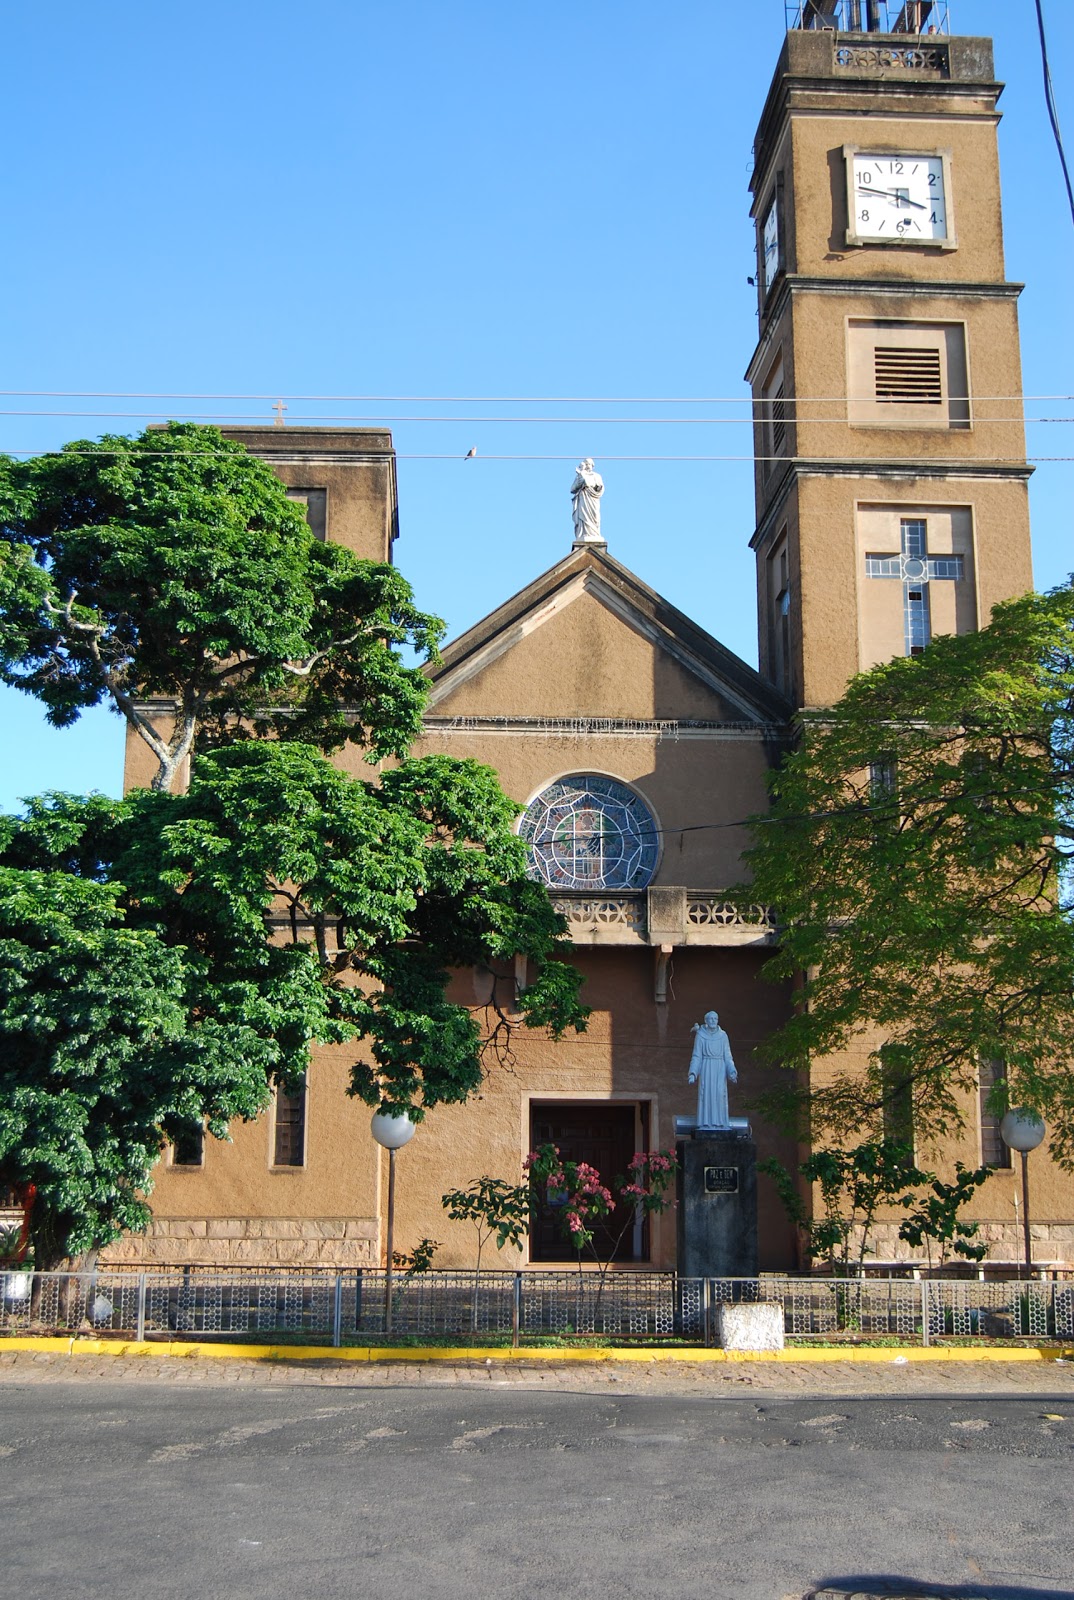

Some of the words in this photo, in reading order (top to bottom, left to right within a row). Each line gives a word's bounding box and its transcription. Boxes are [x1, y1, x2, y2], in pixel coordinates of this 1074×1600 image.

[890, 161, 904, 175] 12
[858, 171, 872, 184] 10
[927, 173, 936, 187] 2
[861, 209, 870, 222] 8
[928, 211, 937, 225] 4
[896, 220, 905, 233] 6
